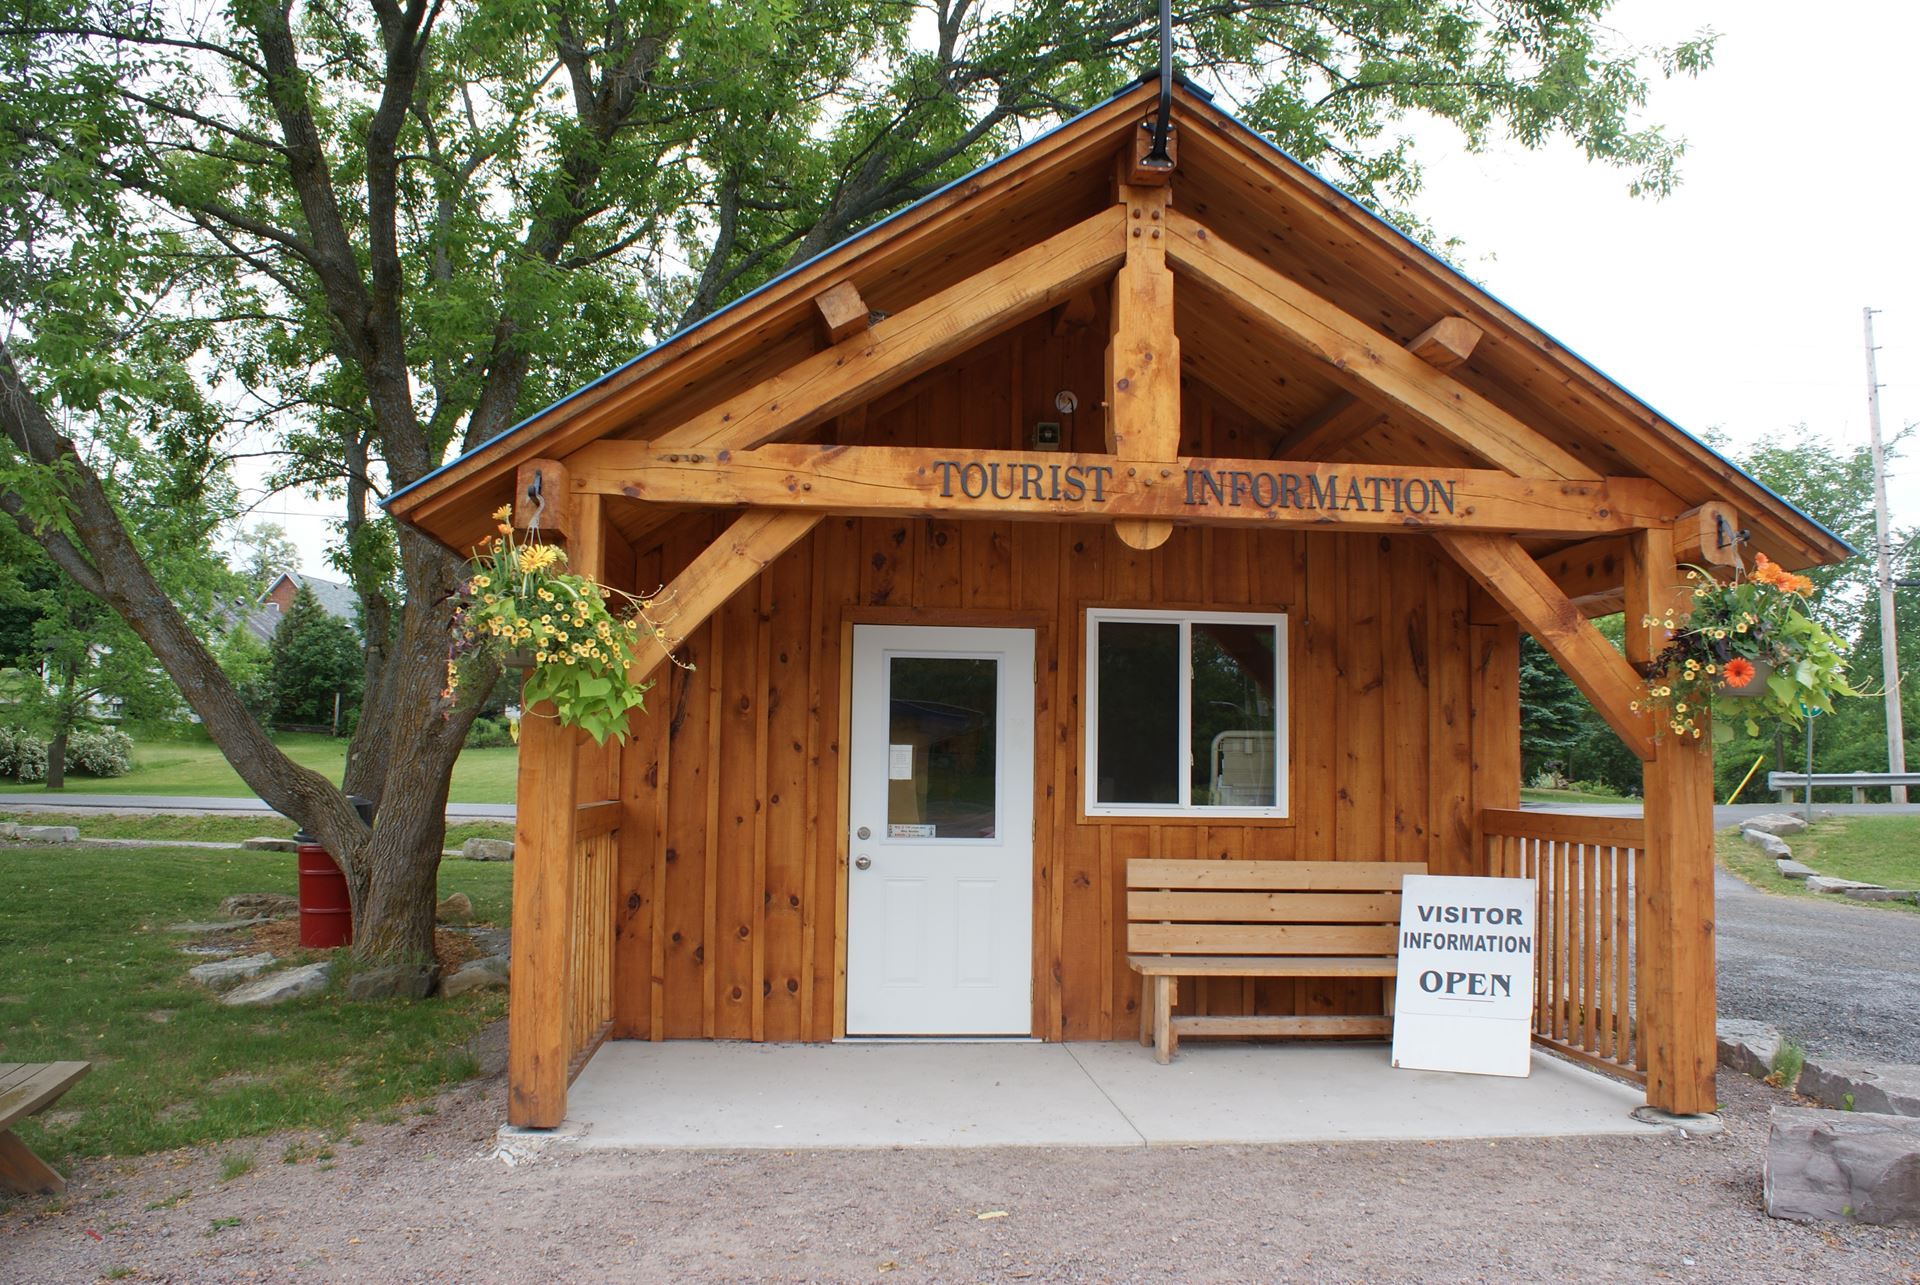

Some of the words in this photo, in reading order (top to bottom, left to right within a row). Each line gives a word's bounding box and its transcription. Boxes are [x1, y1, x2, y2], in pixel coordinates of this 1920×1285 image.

[933, 461, 1112, 503] TOURIST
[1184, 469, 1456, 515] INFORMATION
[1417, 905, 1523, 926] VISITOR
[1403, 931, 1531, 954] INFORMATION
[1419, 970, 1511, 997] OPEN
